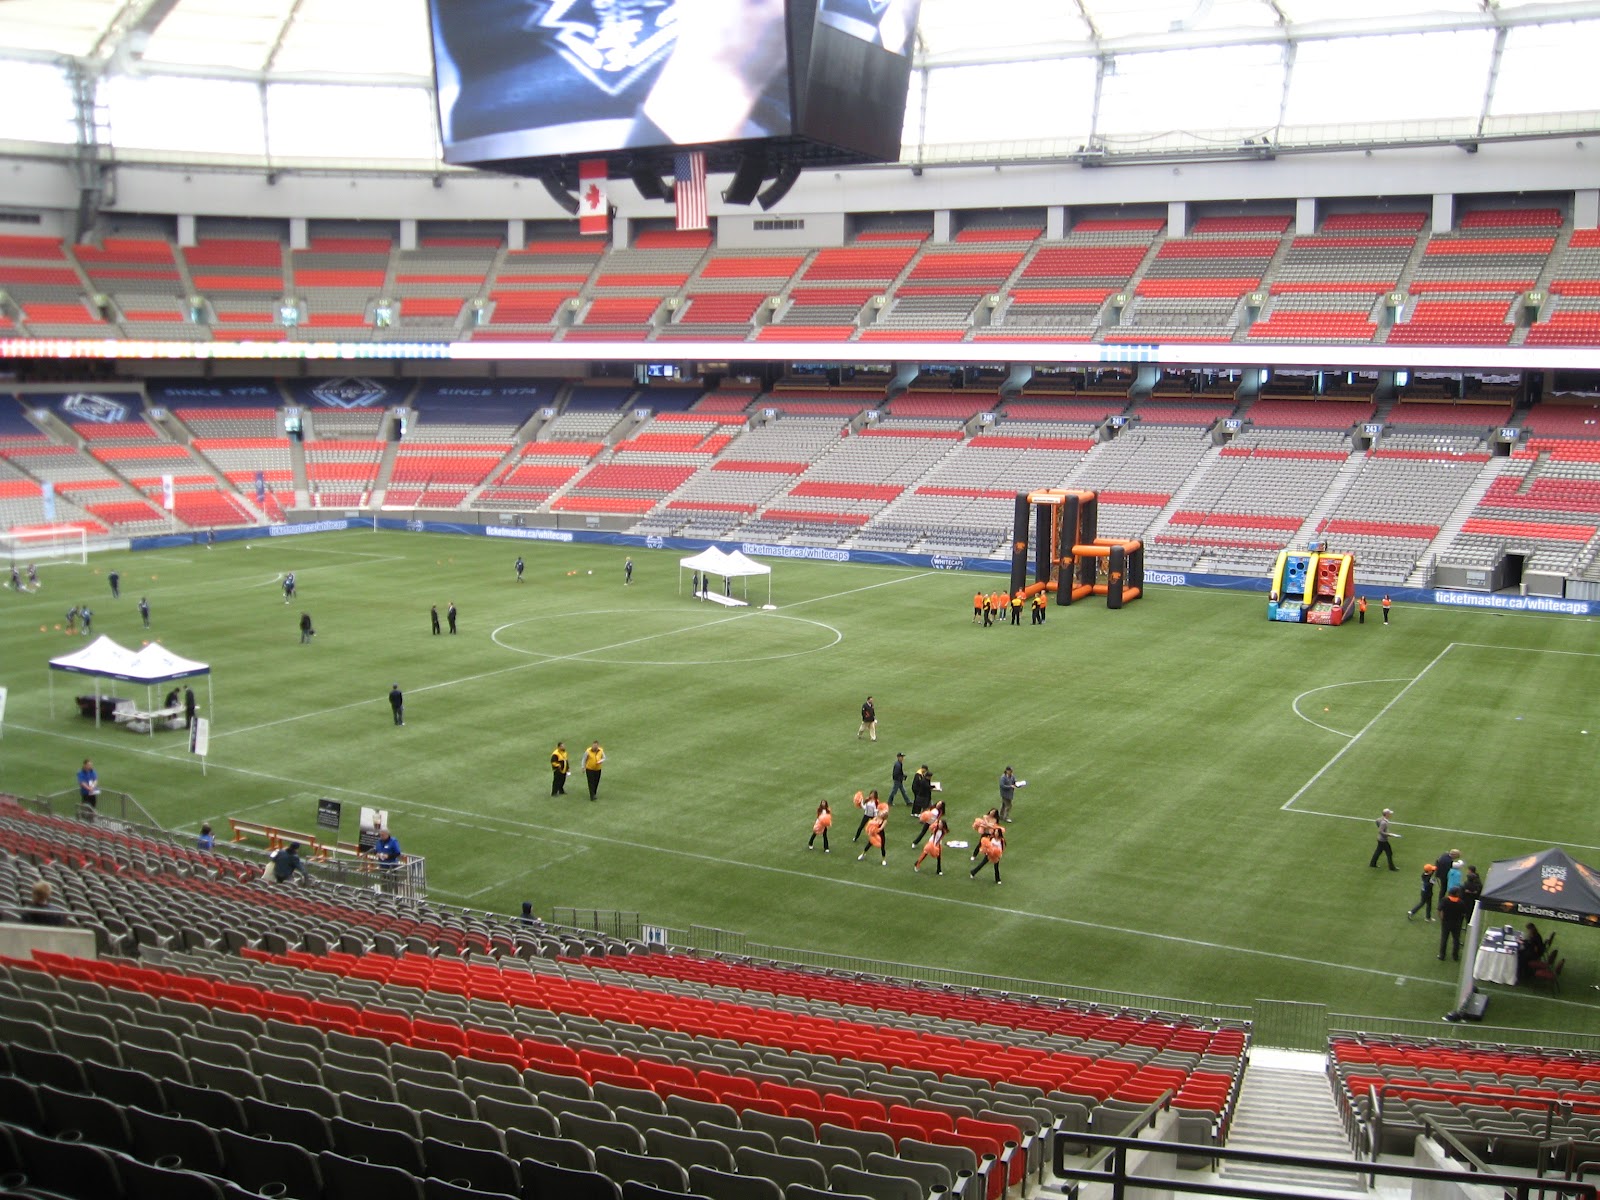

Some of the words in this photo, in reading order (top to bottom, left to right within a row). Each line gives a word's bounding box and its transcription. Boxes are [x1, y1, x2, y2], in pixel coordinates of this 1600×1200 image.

[1391, 293, 1402, 301] 443
[1529, 293, 1541, 301] 444
[164, 387, 222, 397] SINCE
[437, 387, 492, 396] SINCE
[501, 387, 537, 395] 1974
[1112, 417, 1123, 425] 241
[1226, 420, 1237, 428] 242
[1365, 425, 1377, 433] 243
[1501, 429, 1514, 437] 244
[486, 526, 573, 542] ticketmaster.ca/whitecaps
[742, 543, 850, 561] ticketmaster.ca/whitecaps
[933, 558, 964, 566] WHITECAPS
[1144, 571, 1185, 585] hitecaps
[1435, 591, 1589, 615] ticketmaster.ca/whitecaps
[1517, 903, 1580, 922] bclions.com
